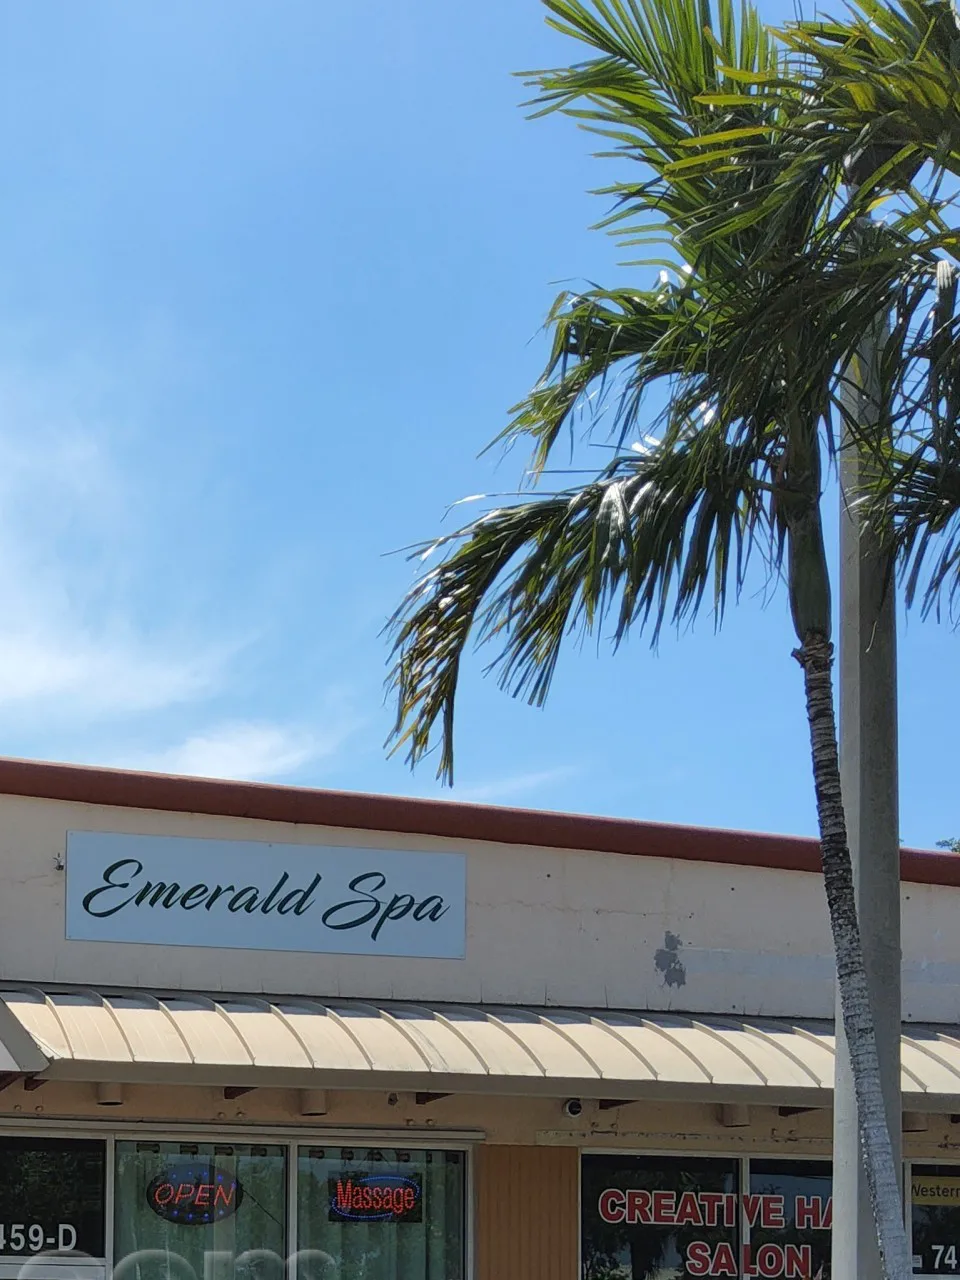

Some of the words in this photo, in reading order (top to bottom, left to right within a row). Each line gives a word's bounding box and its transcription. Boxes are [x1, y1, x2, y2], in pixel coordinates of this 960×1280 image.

[82, 858, 322, 918] Emerald
[321, 871, 451, 942] Spa
[154, 1183, 235, 1206] OPEN
[336, 1179, 415, 1214] Massage
[598, 1188, 785, 1229] CREATIVE
[686, 1241, 811, 1278] SALON
